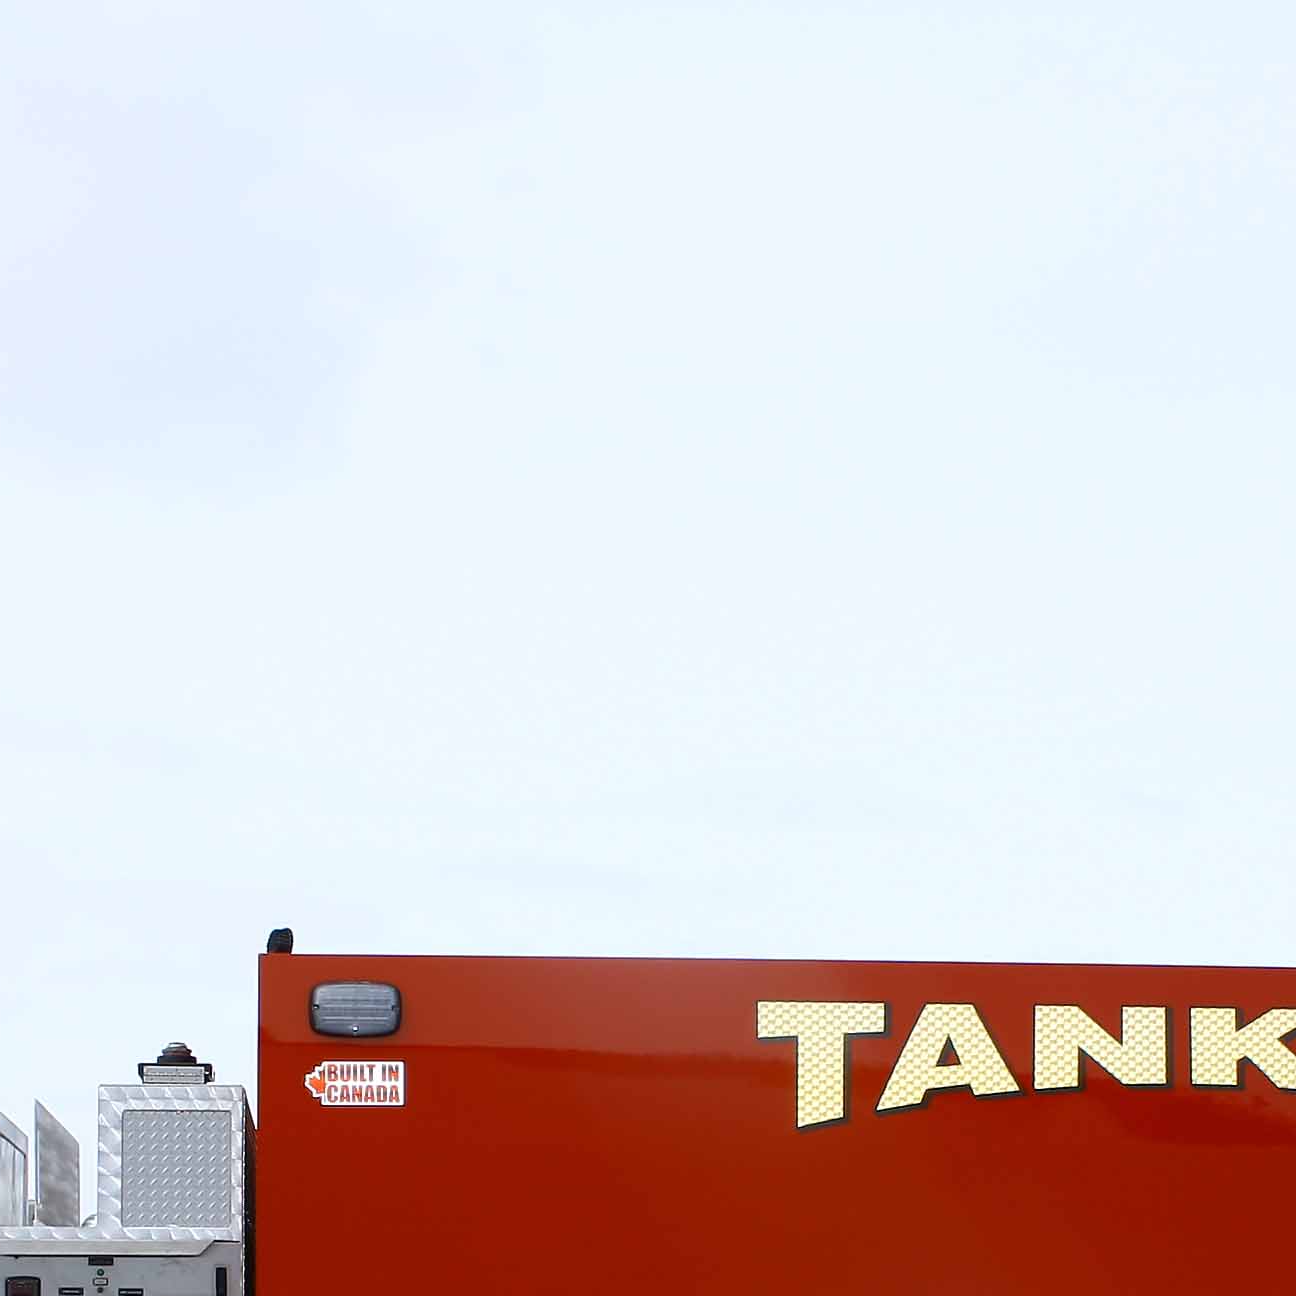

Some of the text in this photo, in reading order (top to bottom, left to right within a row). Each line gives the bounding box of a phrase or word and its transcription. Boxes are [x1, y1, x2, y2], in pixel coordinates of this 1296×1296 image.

[327, 1064, 400, 1082] BUILT IN
[326, 1085, 401, 1103] CANADA
